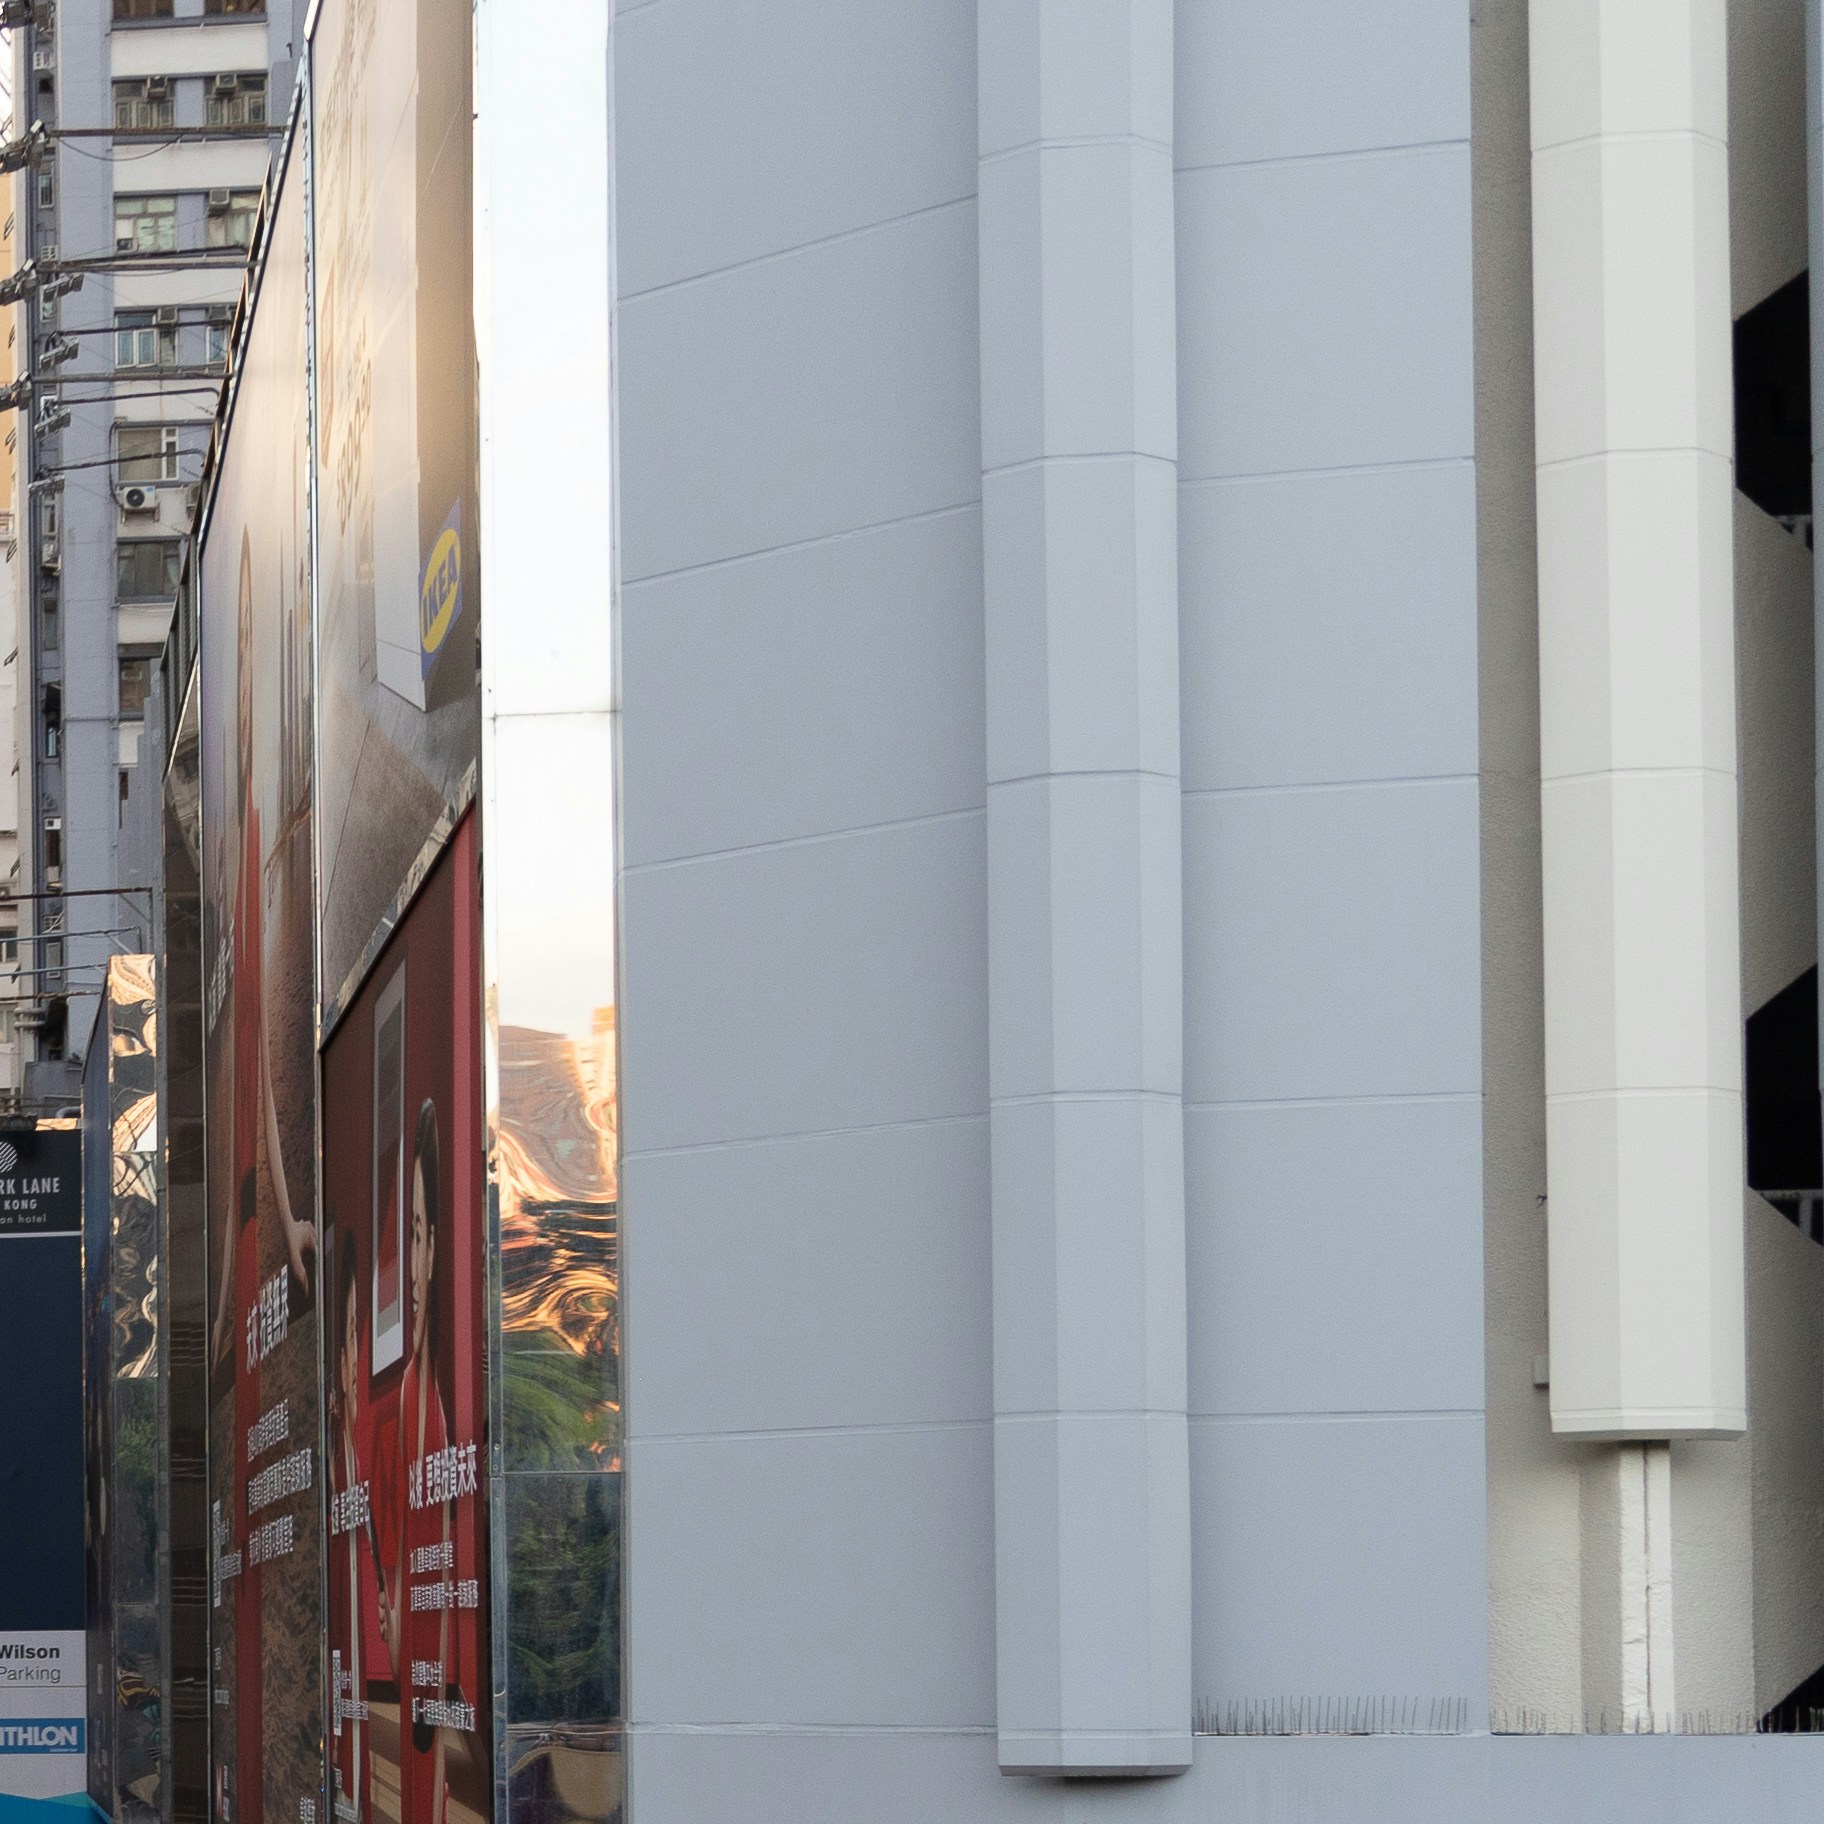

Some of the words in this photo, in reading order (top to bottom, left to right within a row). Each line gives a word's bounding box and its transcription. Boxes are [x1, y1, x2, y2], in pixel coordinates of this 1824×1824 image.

[421, 566, 459, 625] IKEA
[22, 1177, 61, 1194] LANE
[4, 1199, 38, 1210] KONG
[18, 1213, 47, 1224] hotel
